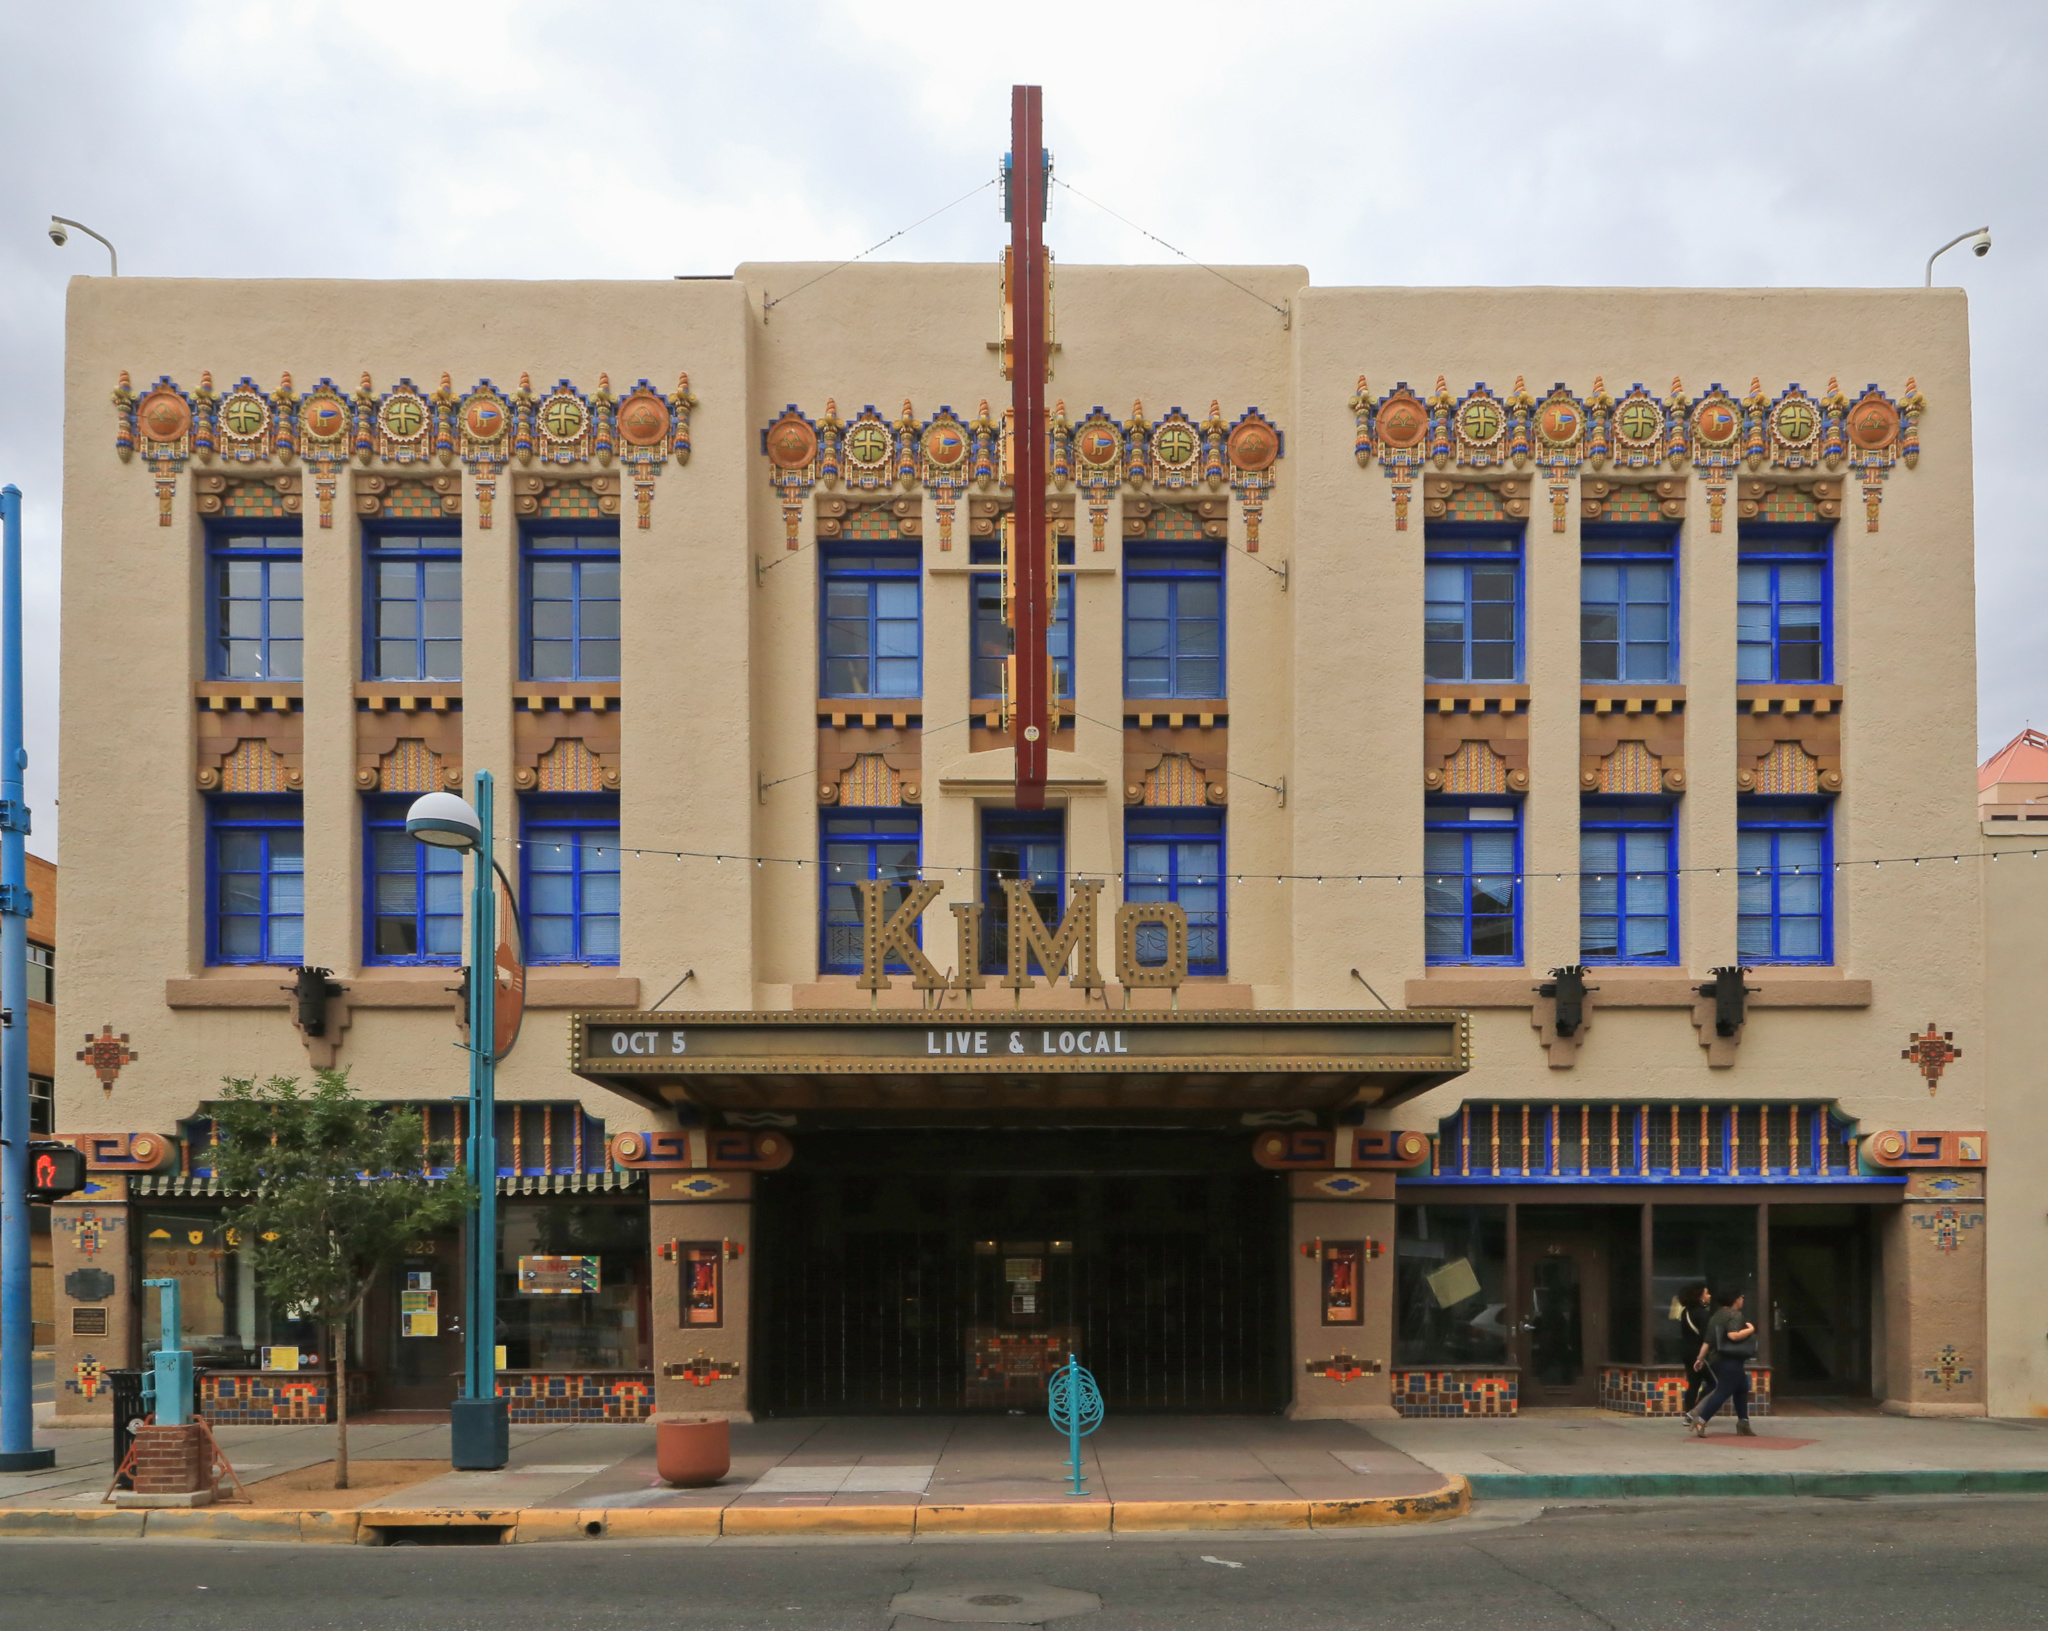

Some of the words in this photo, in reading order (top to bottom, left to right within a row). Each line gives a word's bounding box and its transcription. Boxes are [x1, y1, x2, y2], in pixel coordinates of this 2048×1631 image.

[611, 1032, 659, 1054] OCT
[671, 1032, 686, 1054] 5
[928, 1032, 988, 1054] LIVE
[1009, 1032, 1025, 1054] &
[1043, 1031, 1128, 1054] LOCAL
